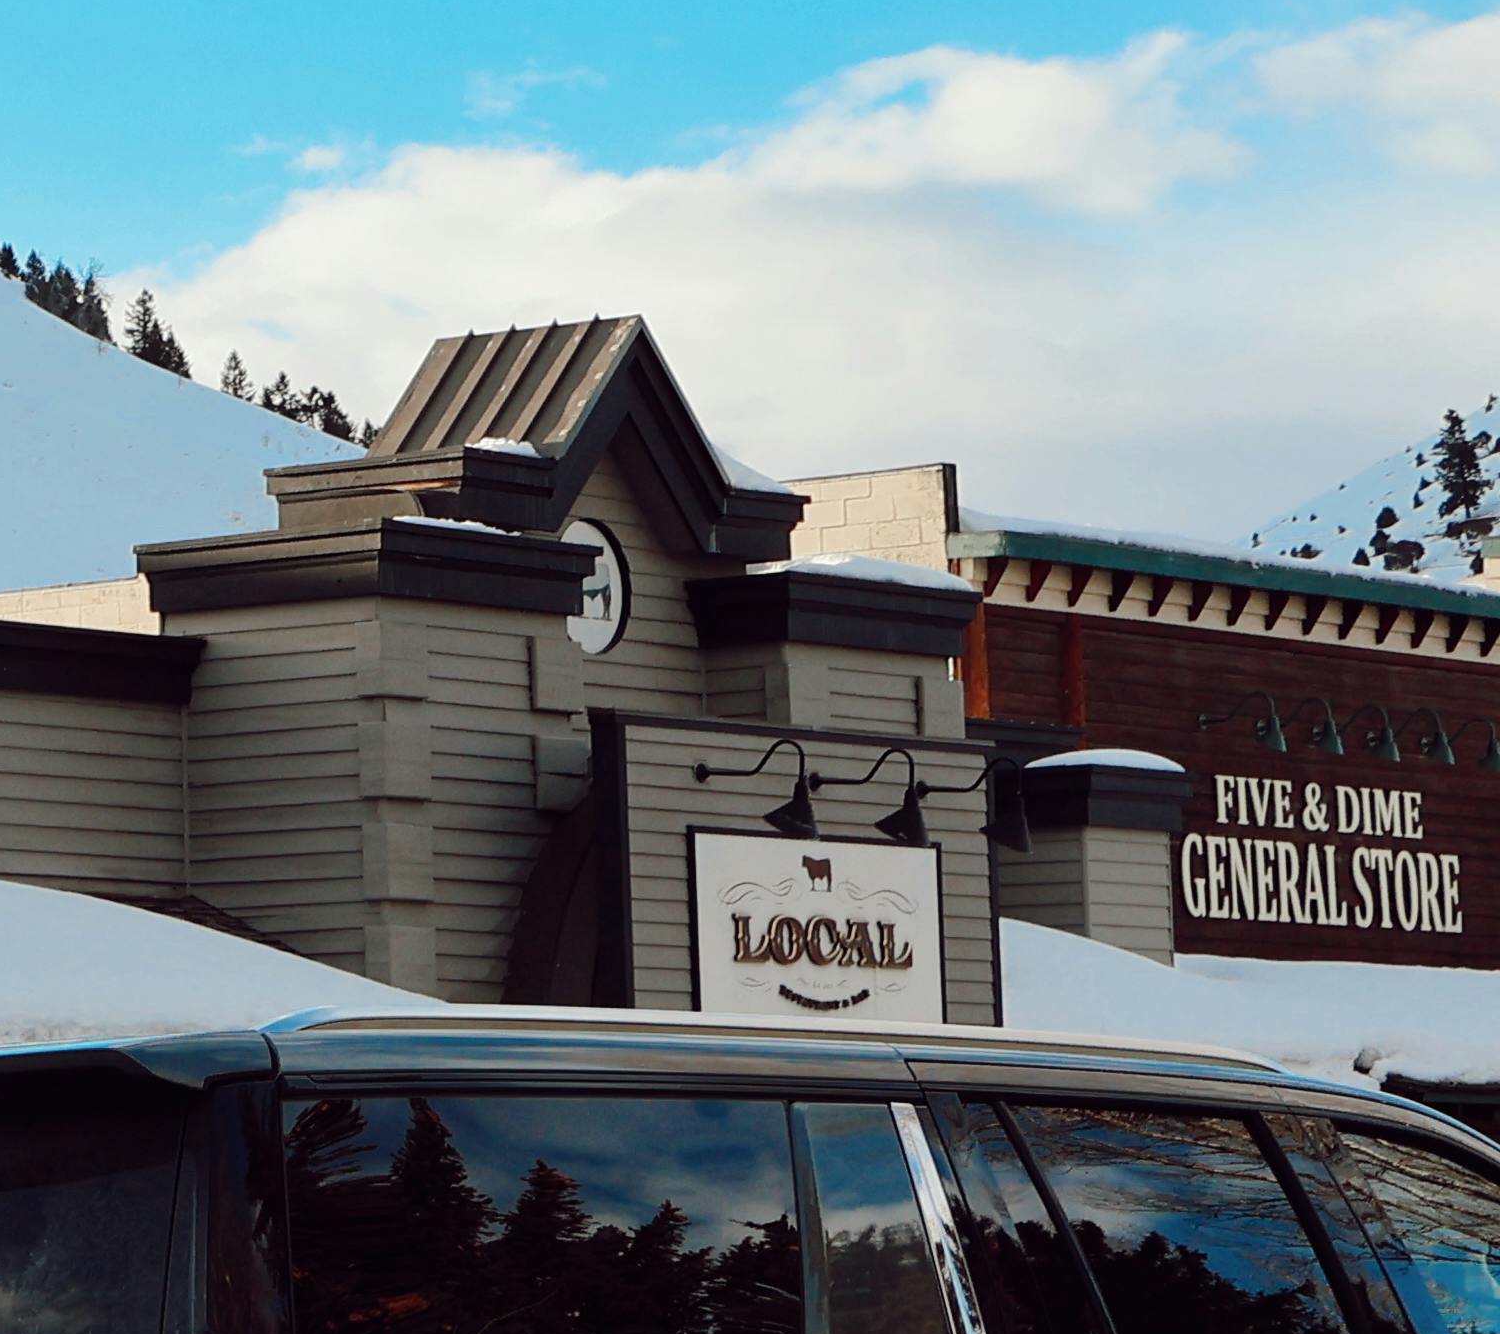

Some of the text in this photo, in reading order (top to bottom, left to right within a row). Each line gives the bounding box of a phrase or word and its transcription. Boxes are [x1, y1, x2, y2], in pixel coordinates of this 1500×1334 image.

[1214, 775, 1424, 840] FIVE & DIME
[1181, 832, 1463, 933] GENERAL STORE
[732, 913, 913, 969] LOCAL
